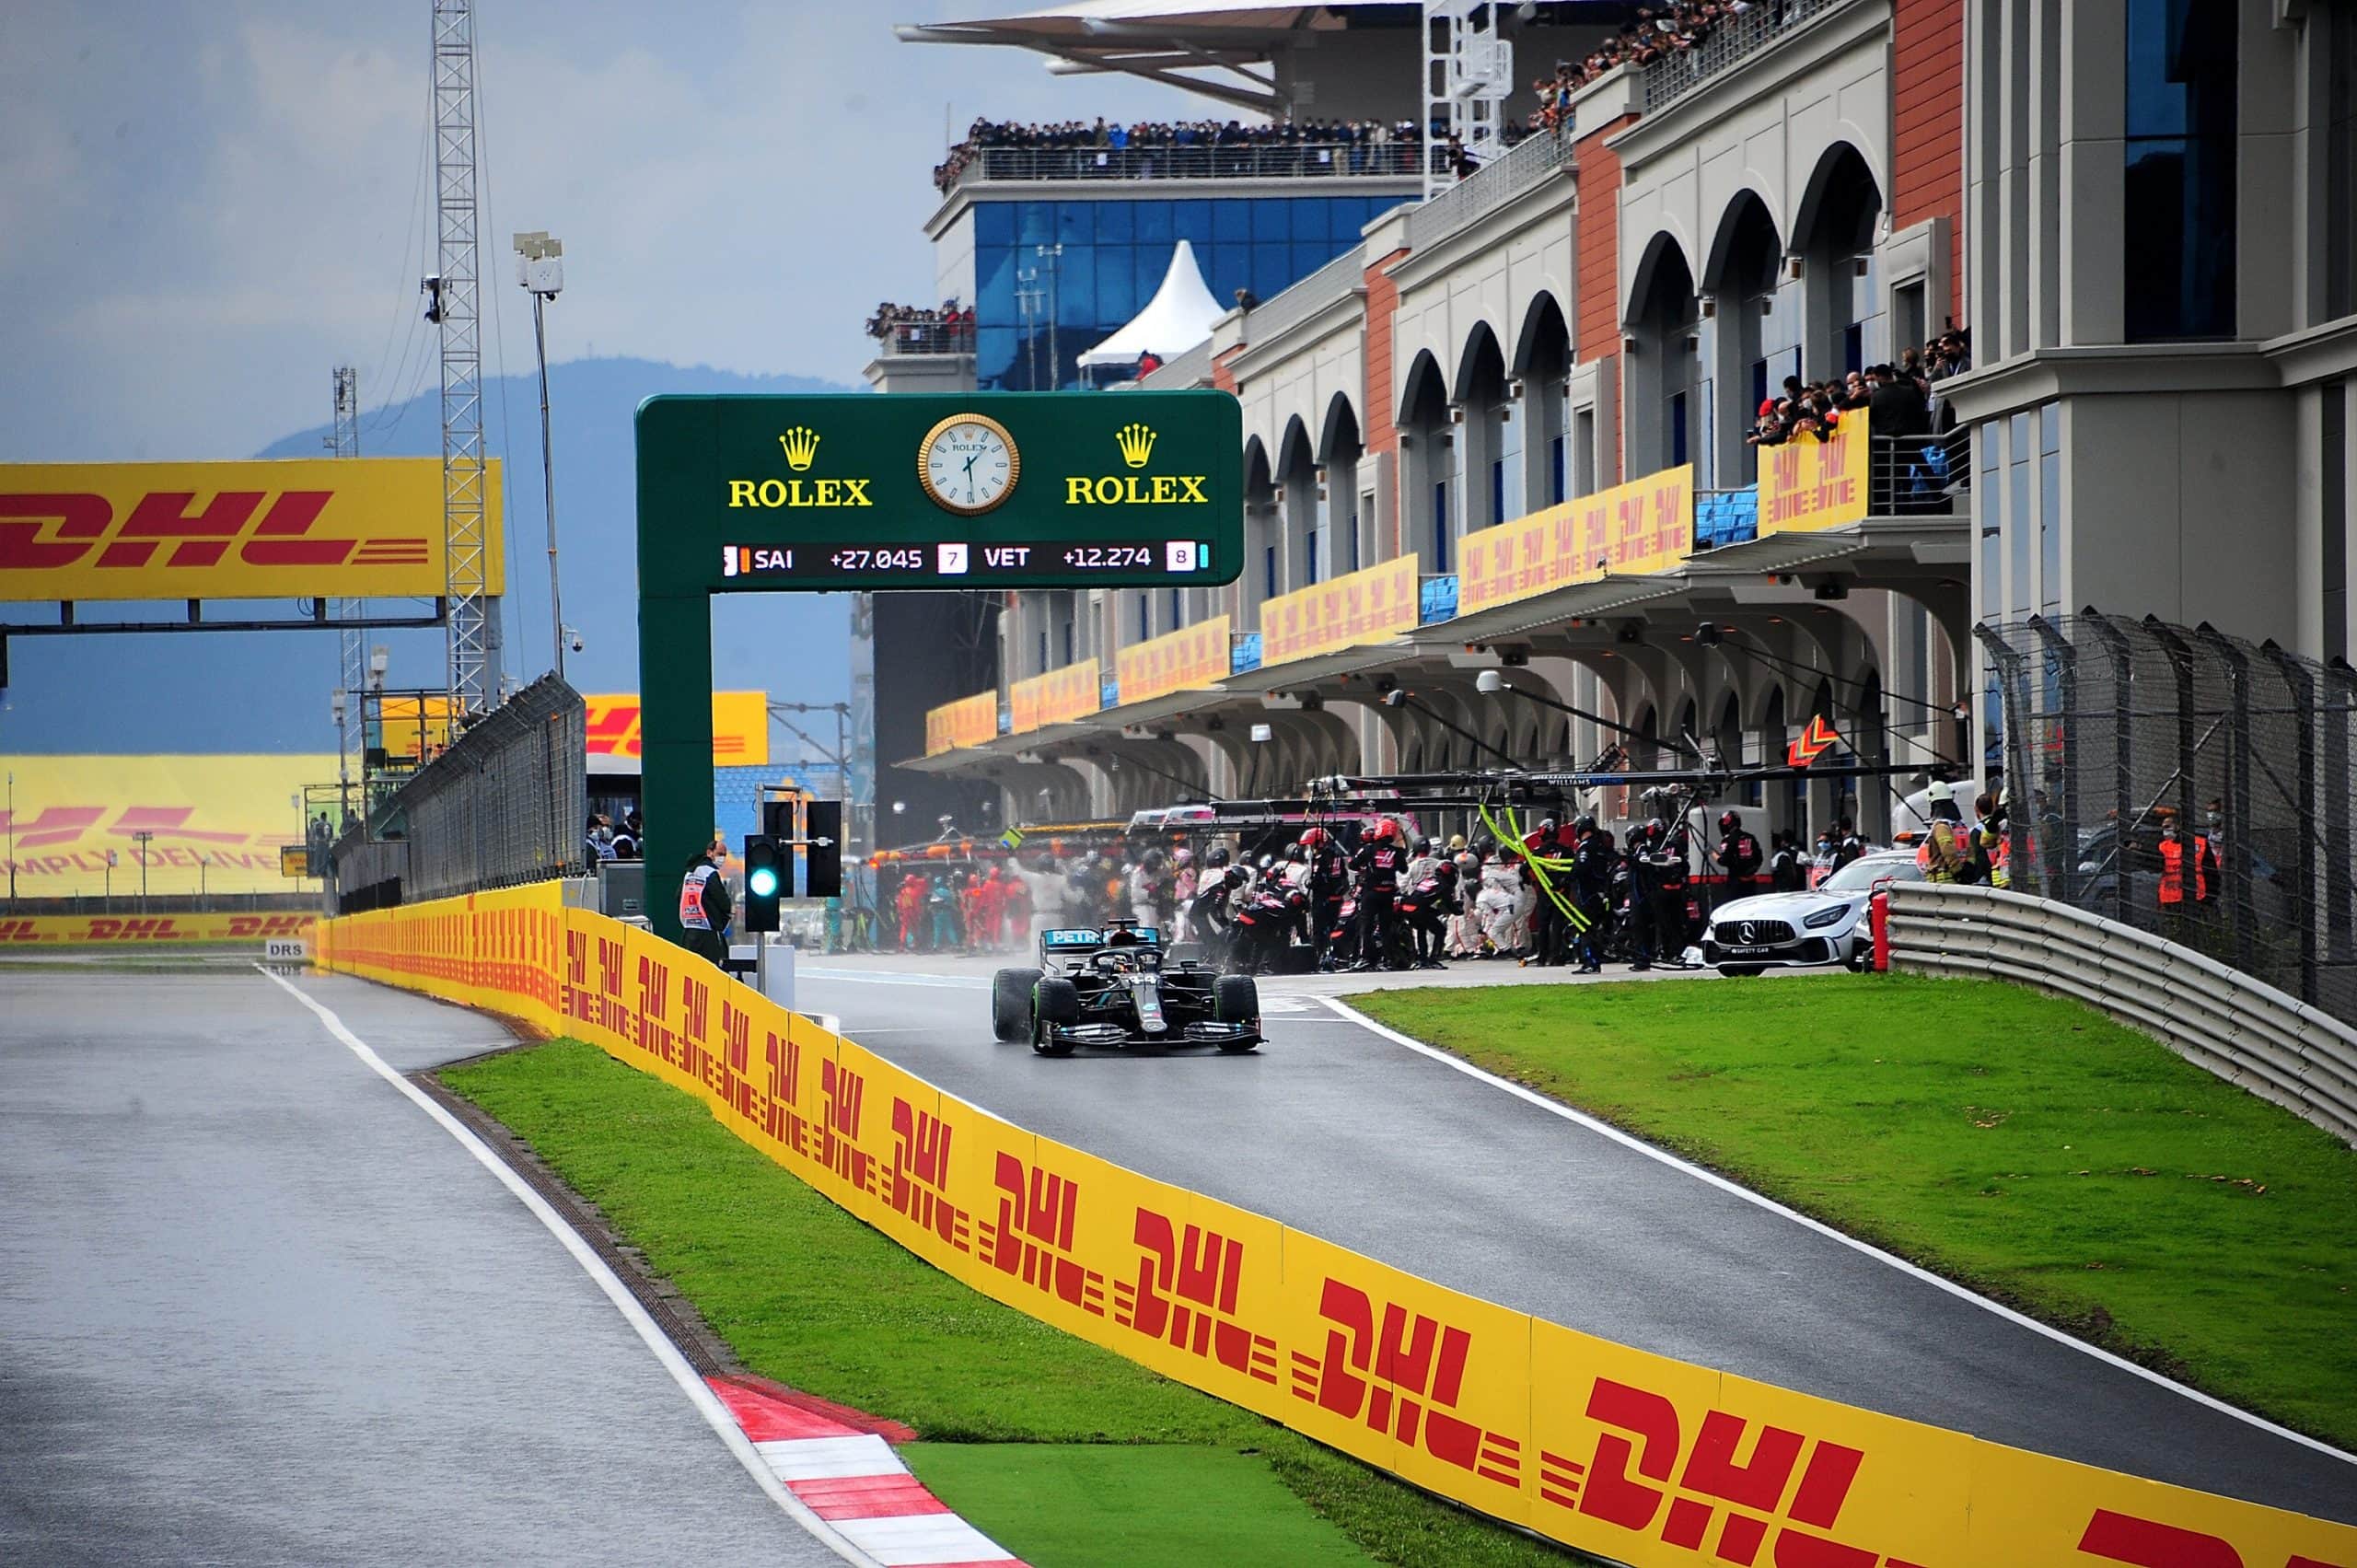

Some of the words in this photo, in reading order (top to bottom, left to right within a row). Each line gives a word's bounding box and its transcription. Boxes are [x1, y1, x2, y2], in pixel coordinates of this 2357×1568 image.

[728, 479, 873, 507] ROLEX
[1065, 475, 1208, 504] ROLEX
[0, 491, 359, 568] DHL
[755, 550, 792, 569] SAI
[830, 550, 923, 569] +27.045
[947, 552, 958, 566] 7
[985, 548, 1030, 566] VET
[1063, 548, 1152, 566] +12.274
[1176, 550, 1187, 563] 8
[1548, 778, 1591, 786] WILLIAMS
[87, 920, 181, 939] DHL
[270, 945, 302, 956] DRS
[1129, 975, 1156, 983] 44
[766, 1031, 801, 1156] DHL
[822, 1058, 866, 1190] DHL
[891, 1097, 954, 1245] DHL
[994, 1150, 1085, 1307] DHL
[1133, 1206, 1252, 1374] DHL
[1318, 1277, 1480, 1469] DHL
[1579, 1377, 1880, 1568] DHL
